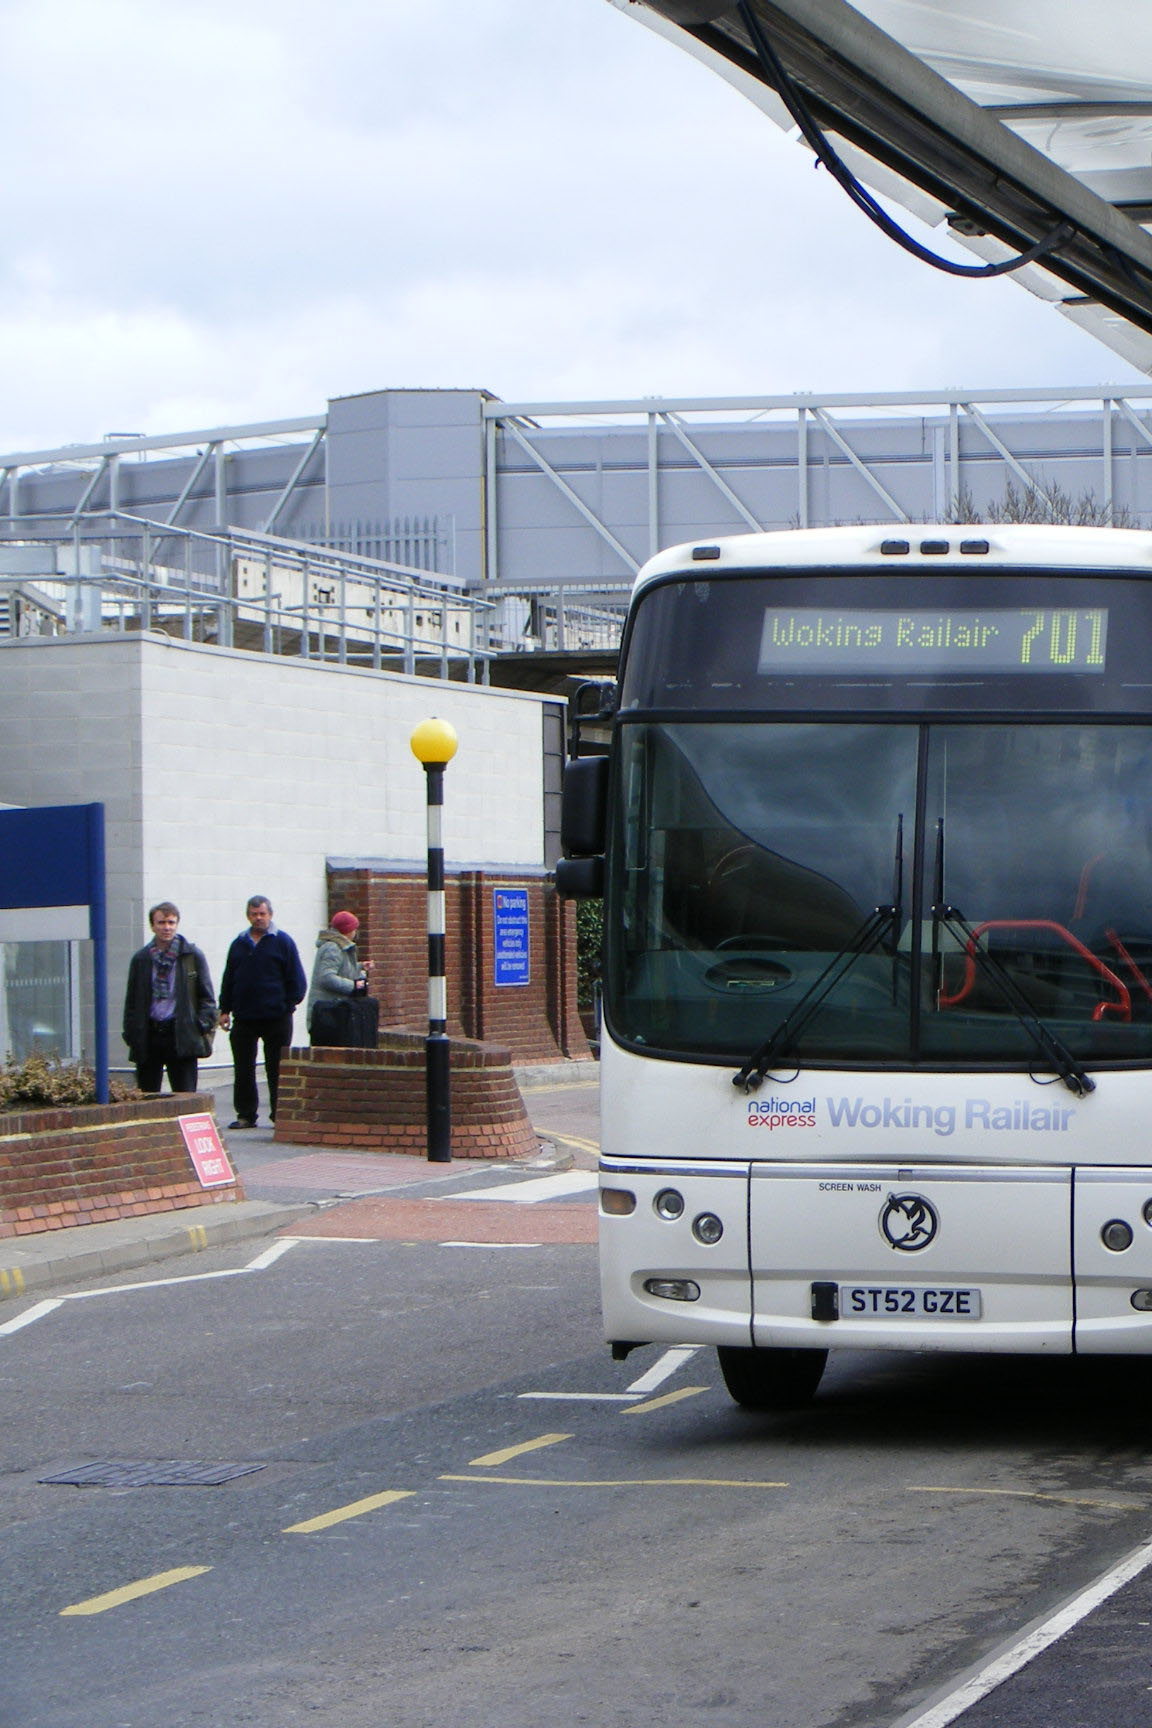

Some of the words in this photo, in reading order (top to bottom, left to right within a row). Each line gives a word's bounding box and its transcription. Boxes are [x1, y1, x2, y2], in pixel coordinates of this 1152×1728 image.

[772, 616, 882, 648] Woking
[897, 616, 999, 648] Railair
[1020, 609, 1103, 663] 701
[503, 896, 509, 908] No
[510, 896, 526, 911] parking
[748, 1096, 816, 1114] national
[748, 1113, 816, 1131] express
[827, 1096, 956, 1137] Woking
[965, 1098, 1076, 1132] Railair
[818, 1182, 853, 1192] SCREEN
[856, 1182, 882, 1192] WASH
[851, 1289, 915, 1313] ST52
[922, 1290, 971, 1314] GZE
